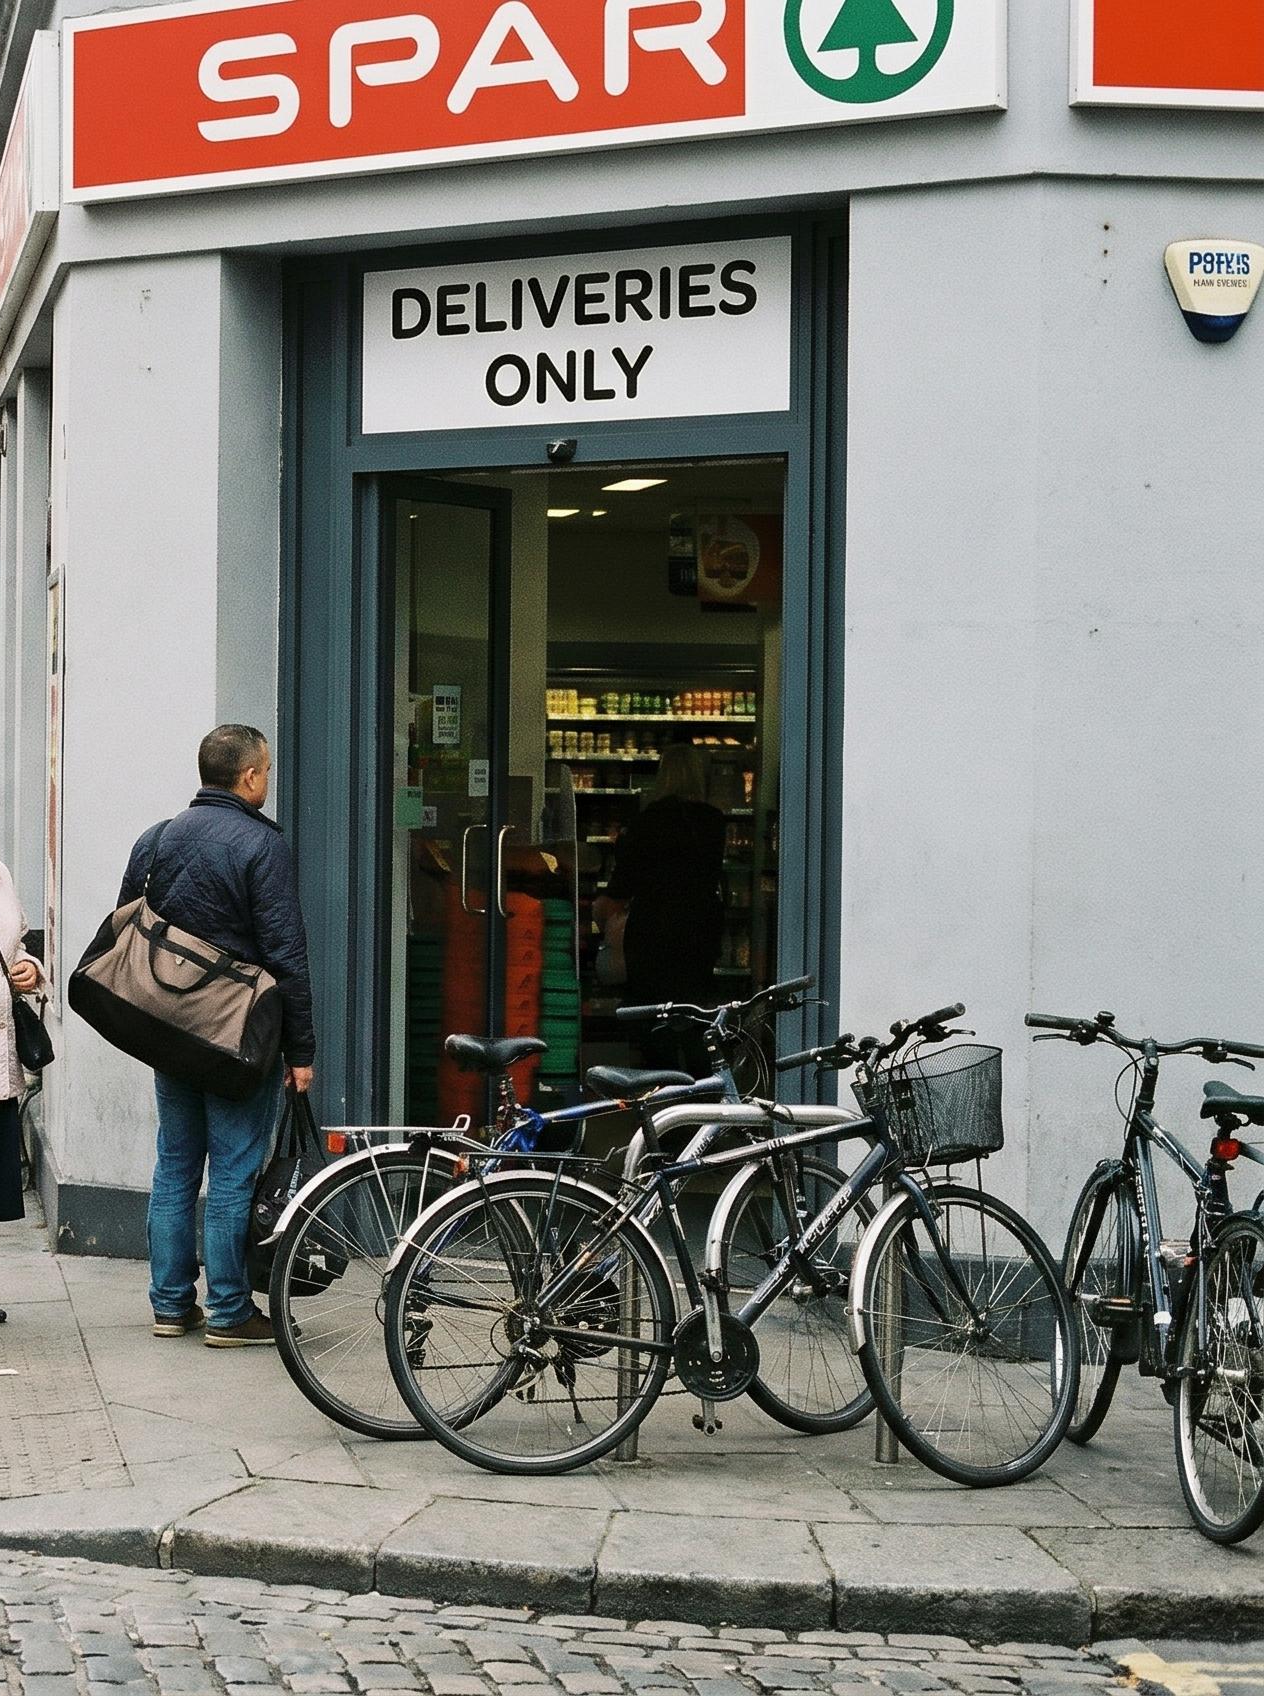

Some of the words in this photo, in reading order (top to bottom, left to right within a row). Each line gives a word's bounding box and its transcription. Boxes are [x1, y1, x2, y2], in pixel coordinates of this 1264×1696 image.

[197, 0, 727, 142] SPAR
[392, 259, 758, 340] DELIVERIES
[486, 345, 654, 407] ONLY
